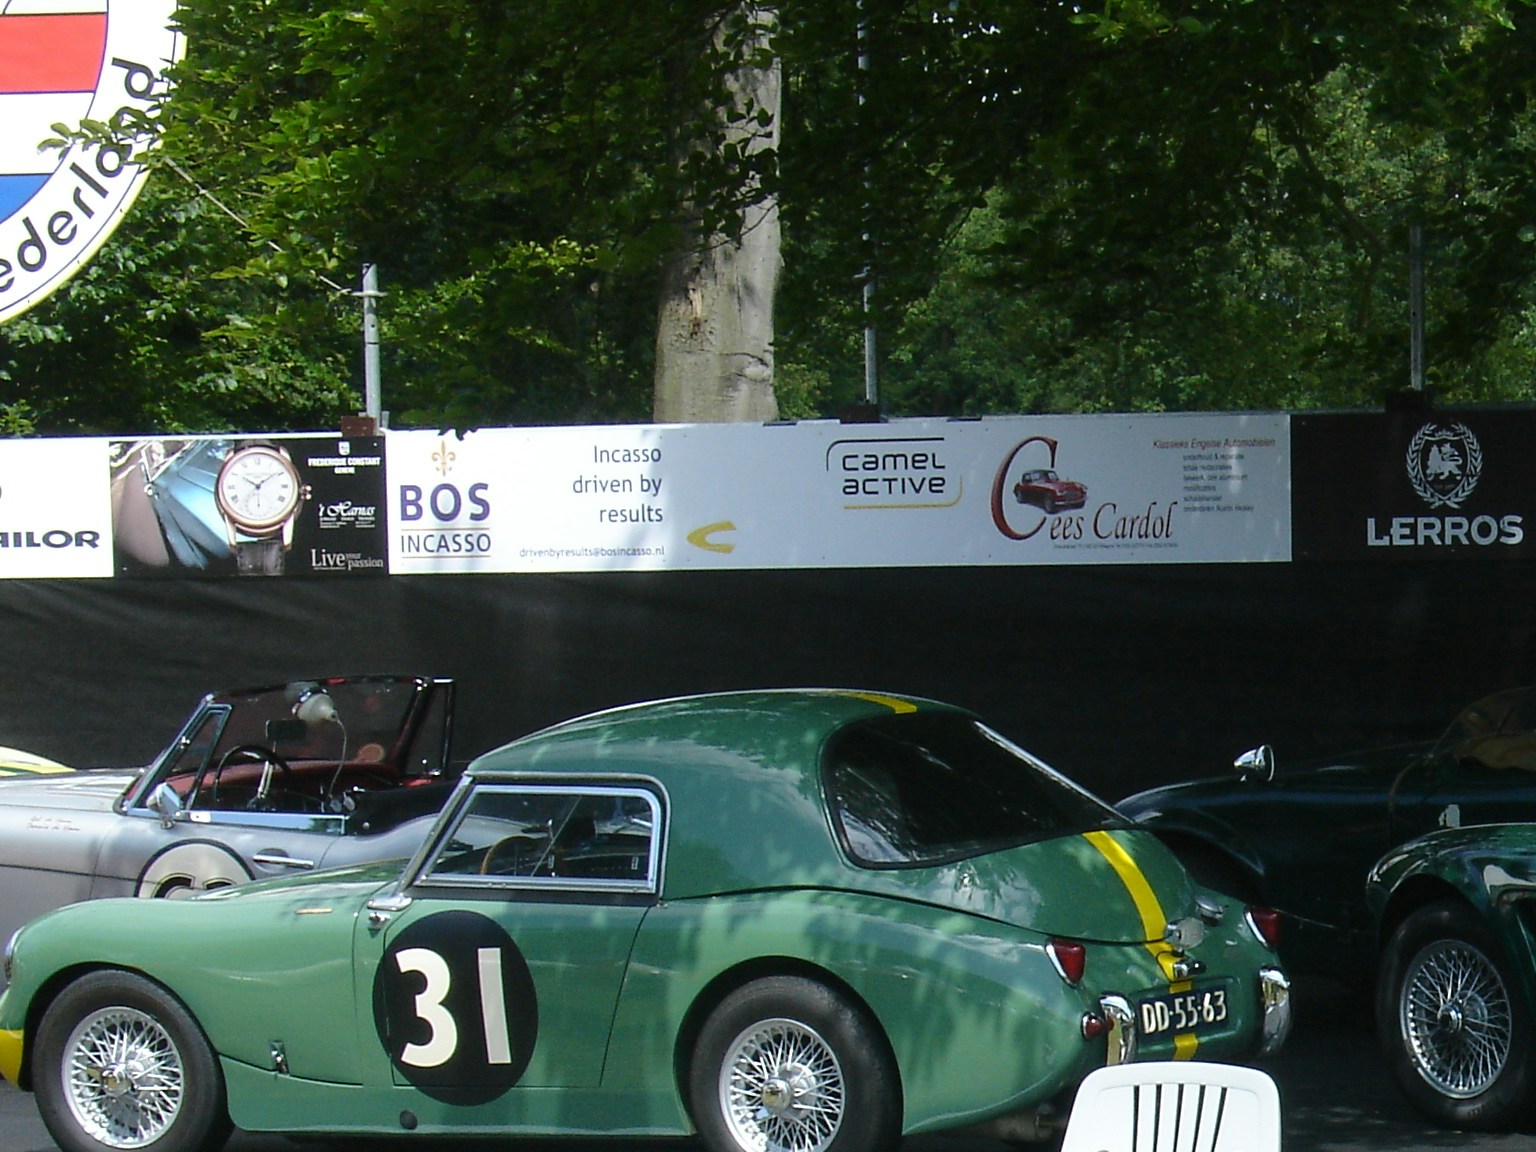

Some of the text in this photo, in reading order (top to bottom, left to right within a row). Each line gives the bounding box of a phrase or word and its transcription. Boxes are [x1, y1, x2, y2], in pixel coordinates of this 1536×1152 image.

[0, 57, 155, 292] ederlad
[594, 445, 662, 463] Incasso
[842, 453, 946, 471] camel
[572, 474, 662, 496] driven by
[399, 483, 491, 522] BOS
[599, 504, 663, 523] results
[1093, 502, 1178, 540] Cardol
[1367, 515, 1524, 546] LERROS
[400, 534, 491, 553] INCASSO
[312, 549, 345, 567] Live
[395, 947, 512, 1068] 31
